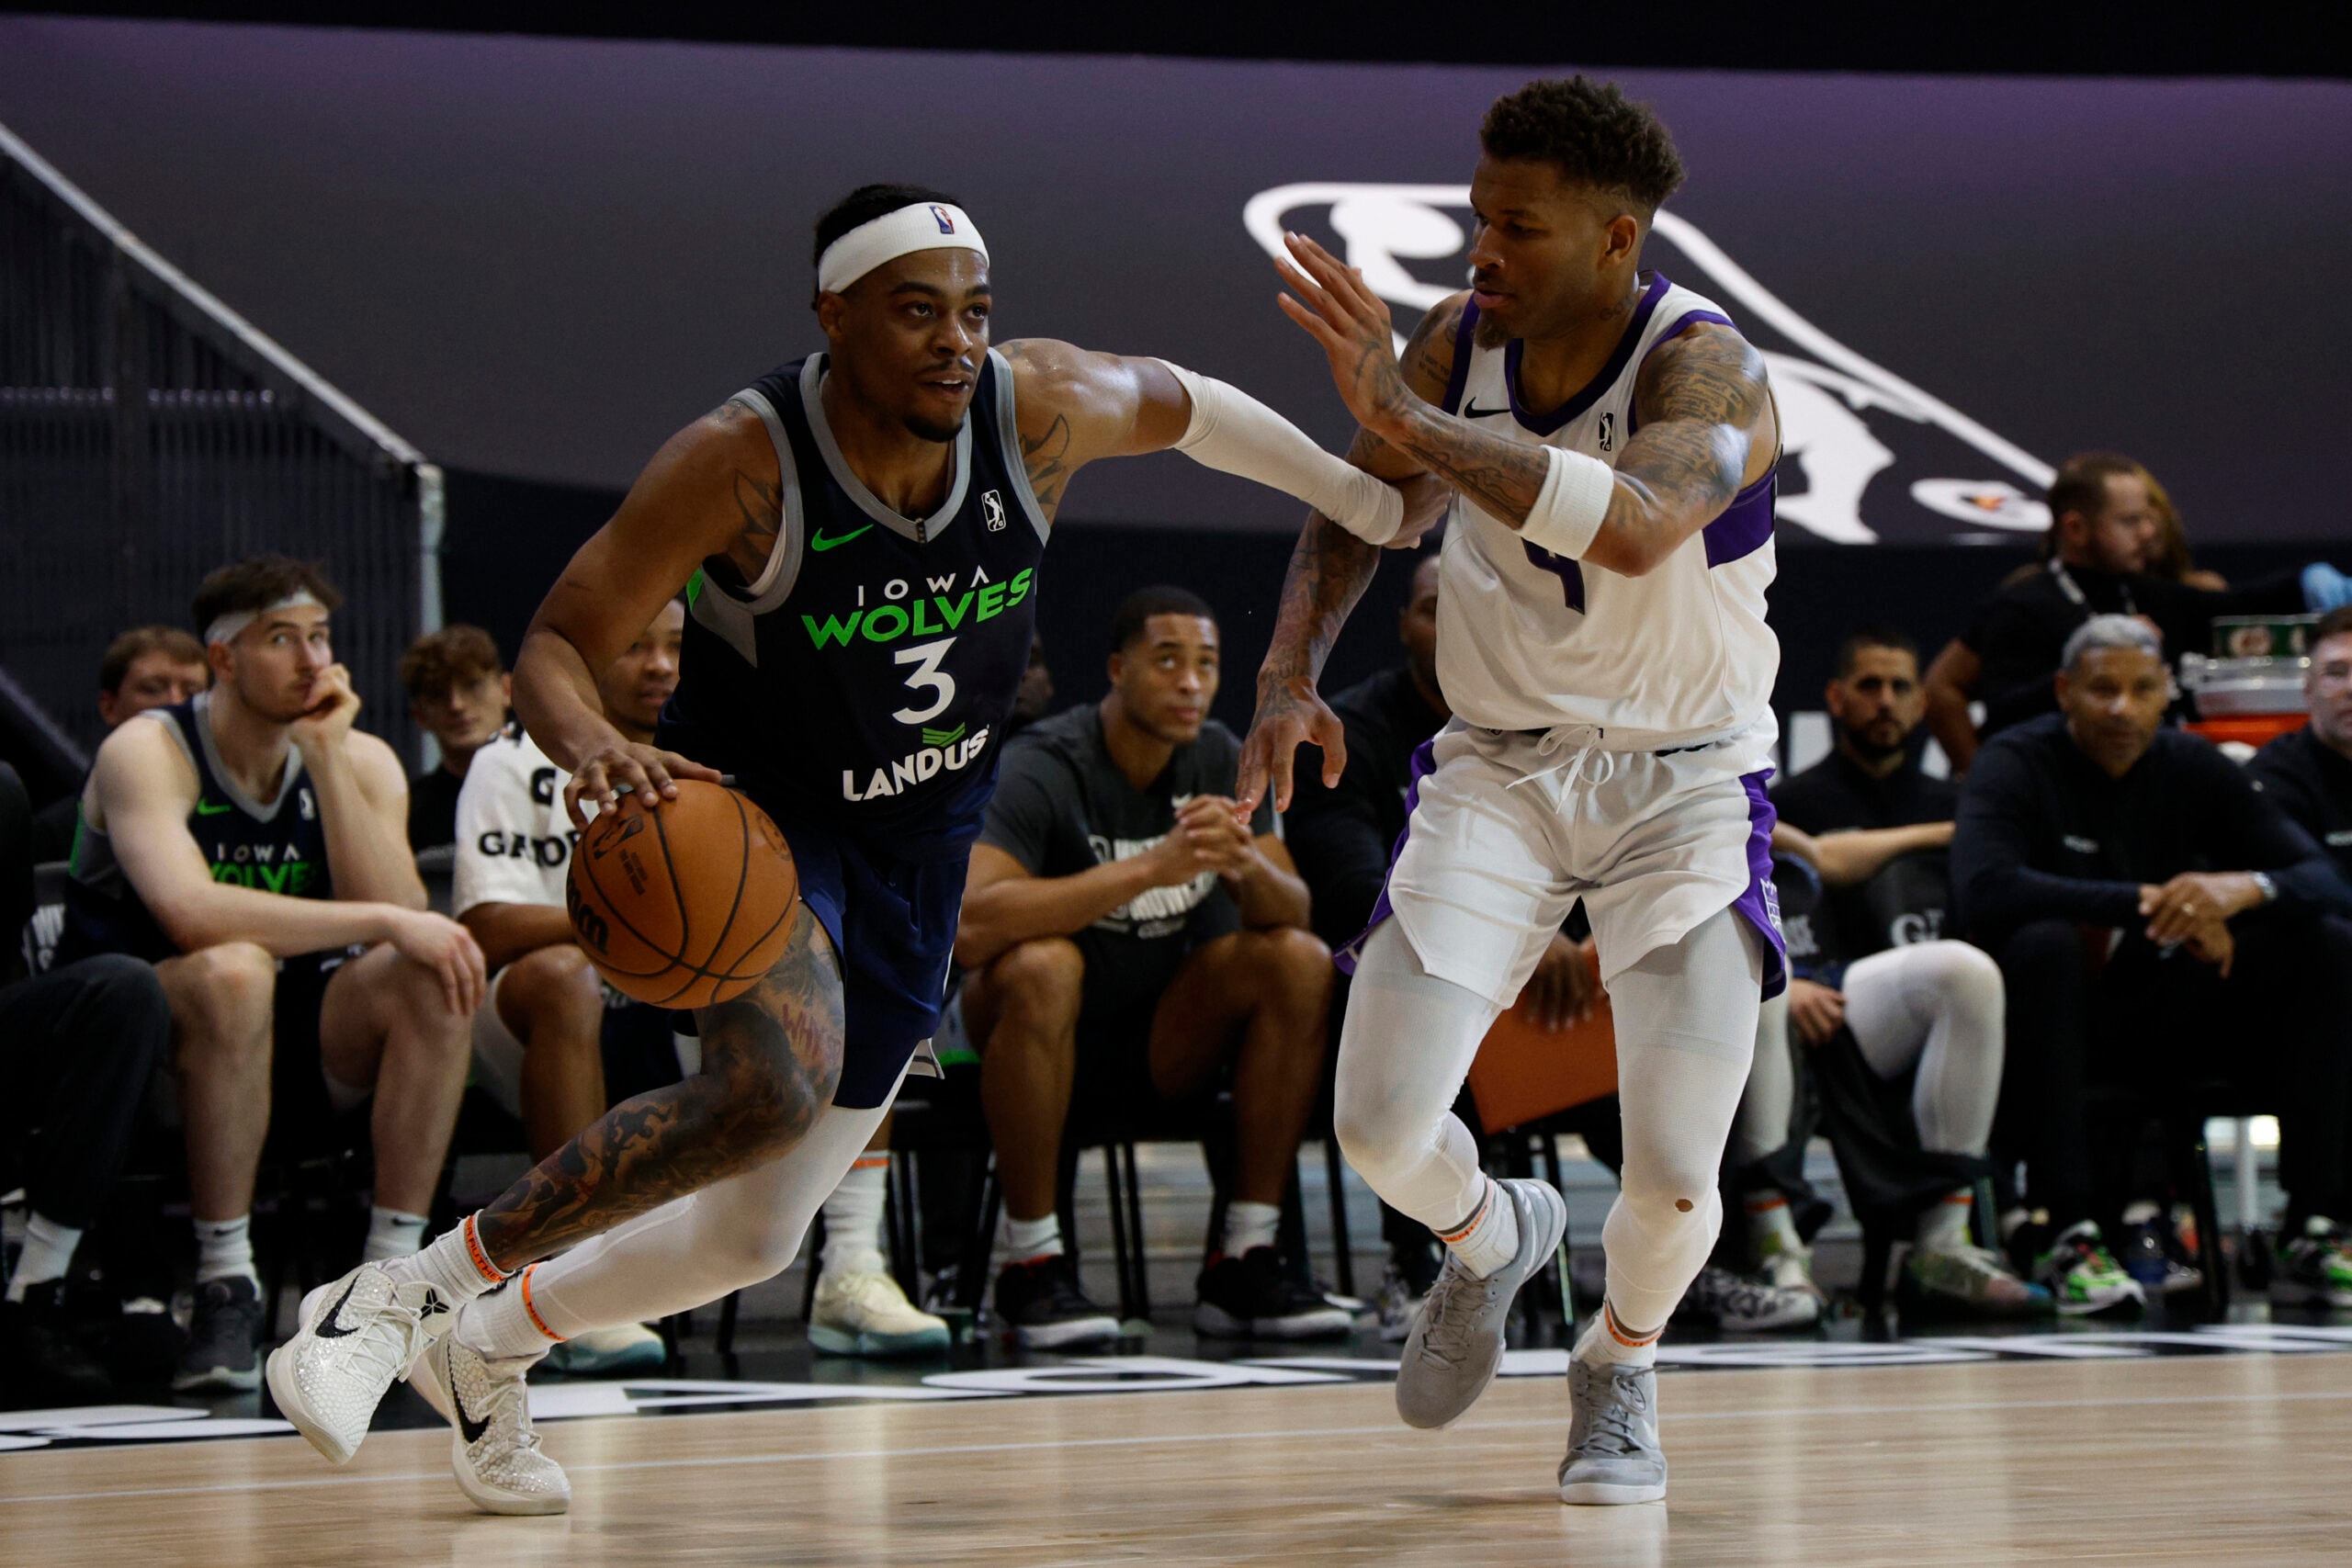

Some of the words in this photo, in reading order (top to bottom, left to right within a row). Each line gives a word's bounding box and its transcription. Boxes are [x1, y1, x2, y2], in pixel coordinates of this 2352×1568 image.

[801, 567, 1034, 650] WOLVES
[857, 564, 989, 607] IOWA
[891, 636, 958, 725] 3
[842, 727, 989, 802] LANDUS
[216, 841, 301, 863] IOWA
